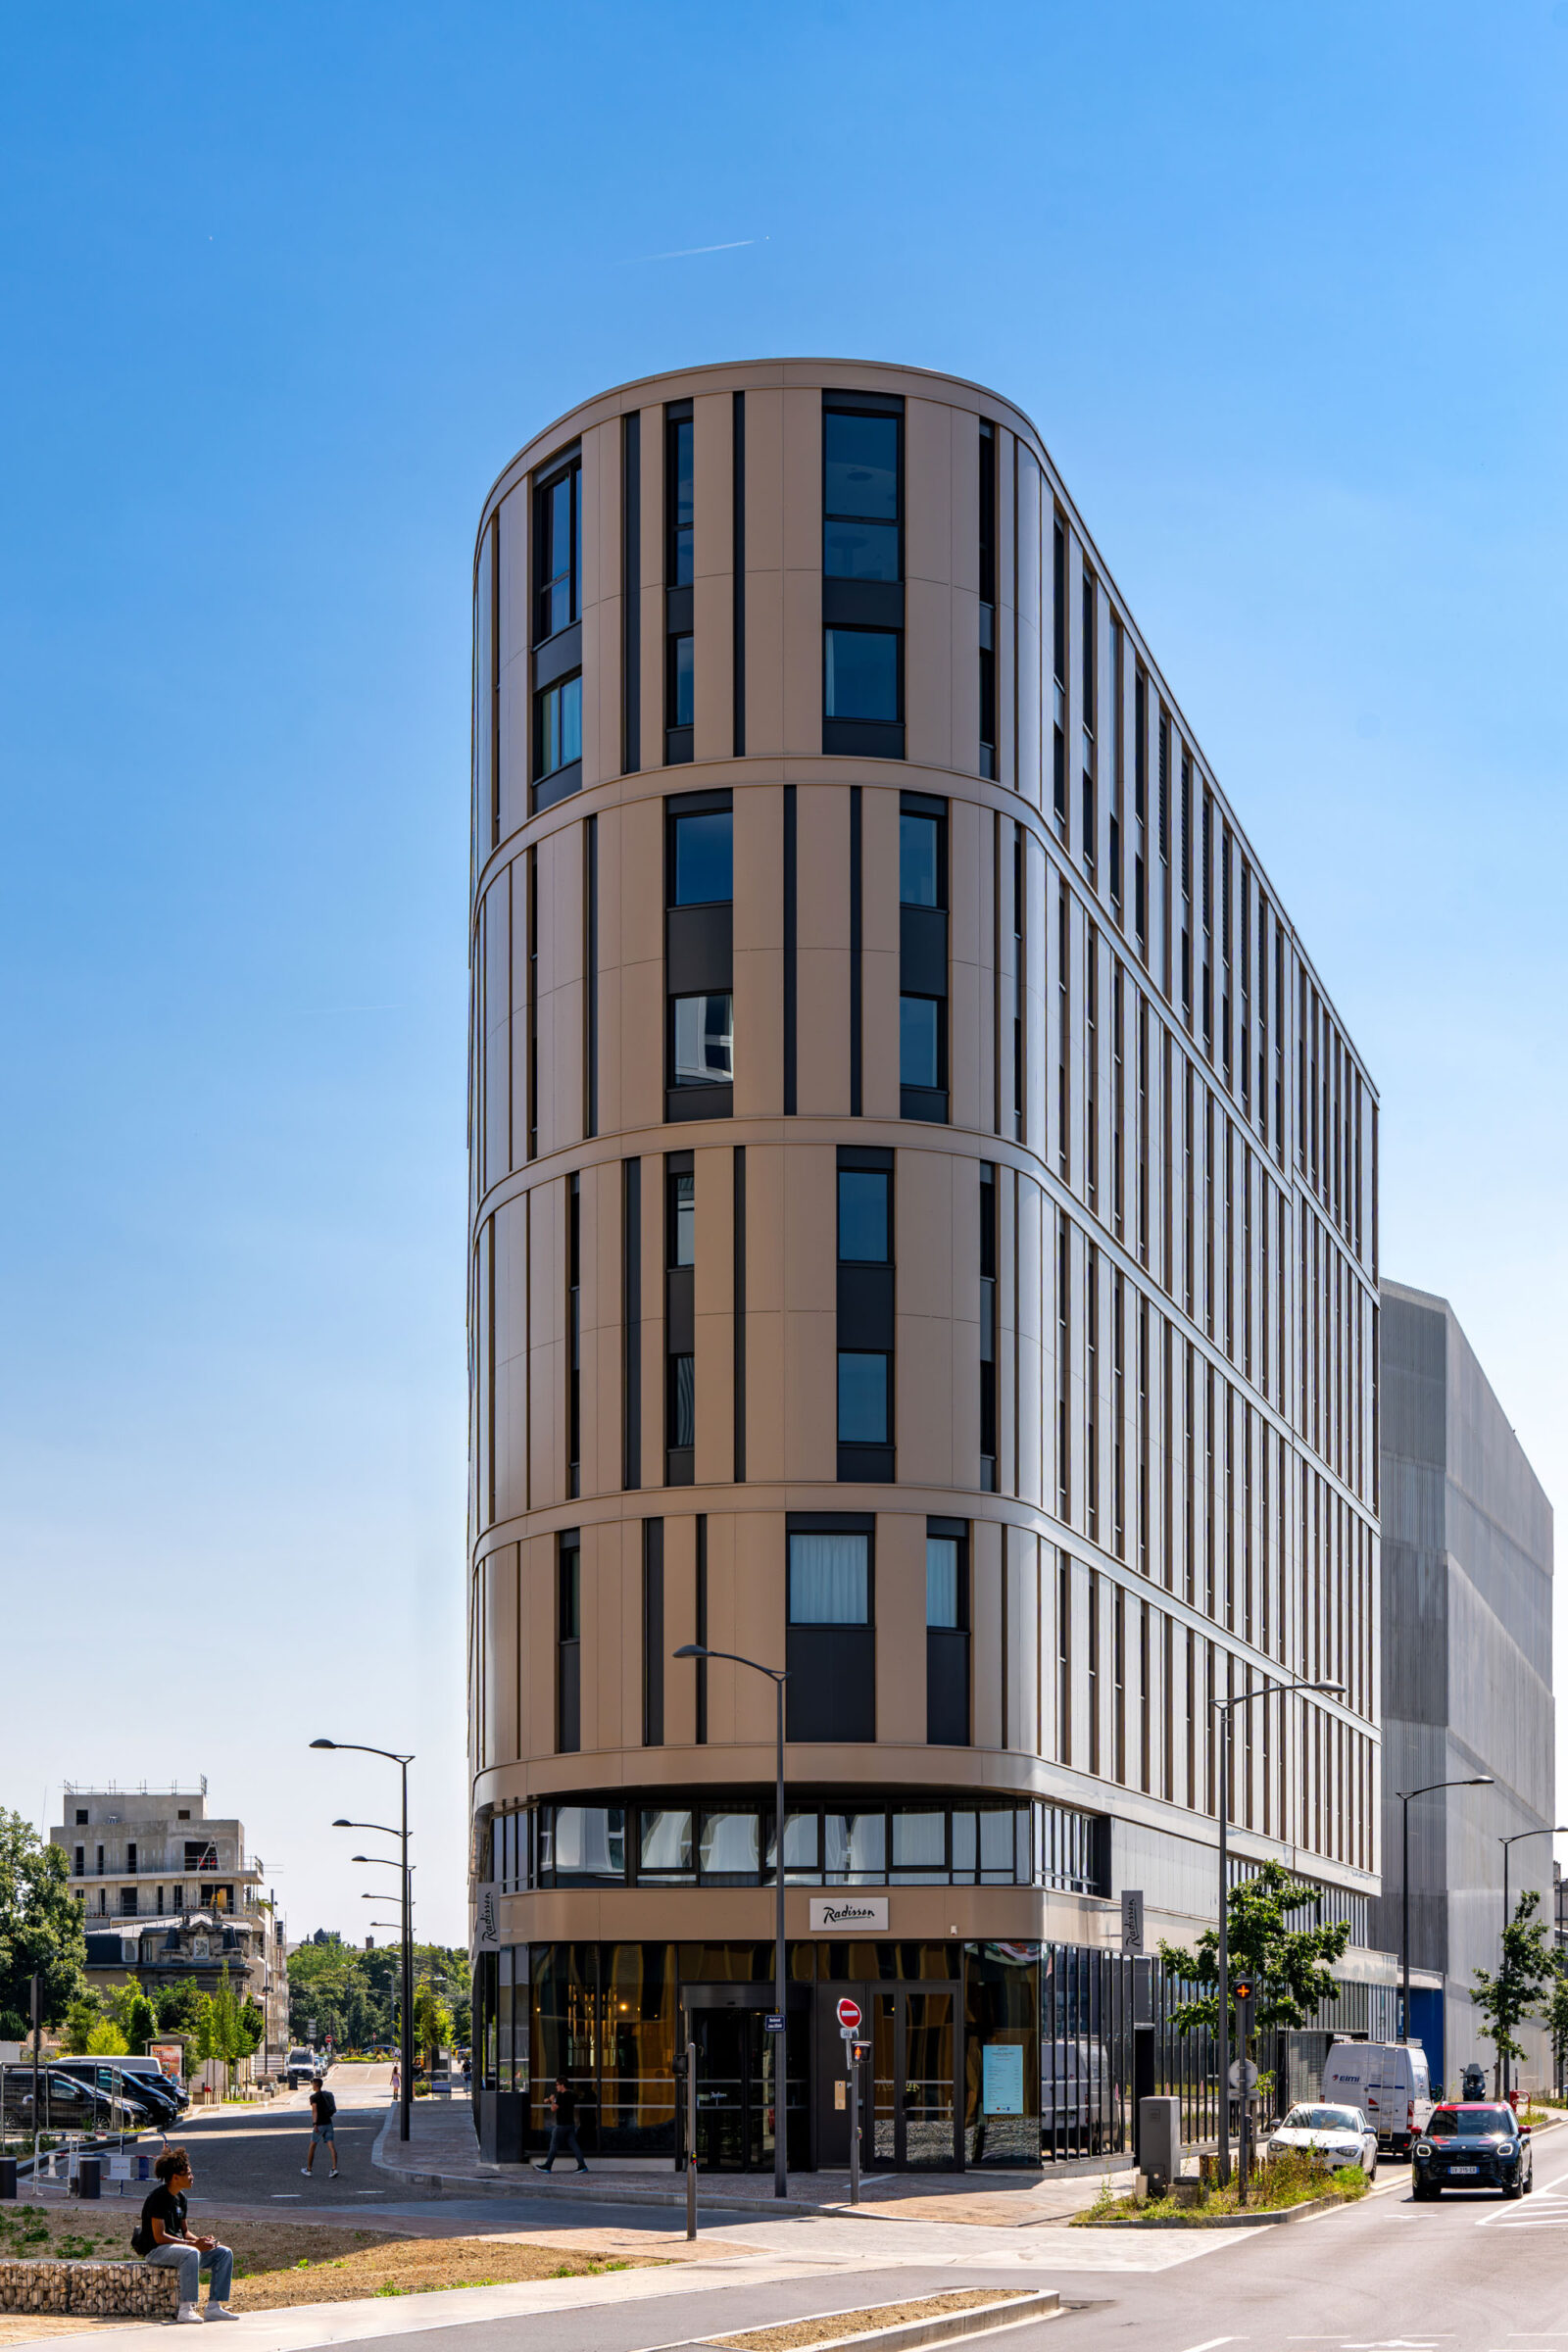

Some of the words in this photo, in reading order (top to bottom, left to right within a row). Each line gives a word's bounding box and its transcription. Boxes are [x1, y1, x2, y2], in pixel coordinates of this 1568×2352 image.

[480, 1891, 498, 1941] Radisson
[823, 1904, 875, 1924] Radisson
[1123, 1898, 1141, 1946] Radisson
